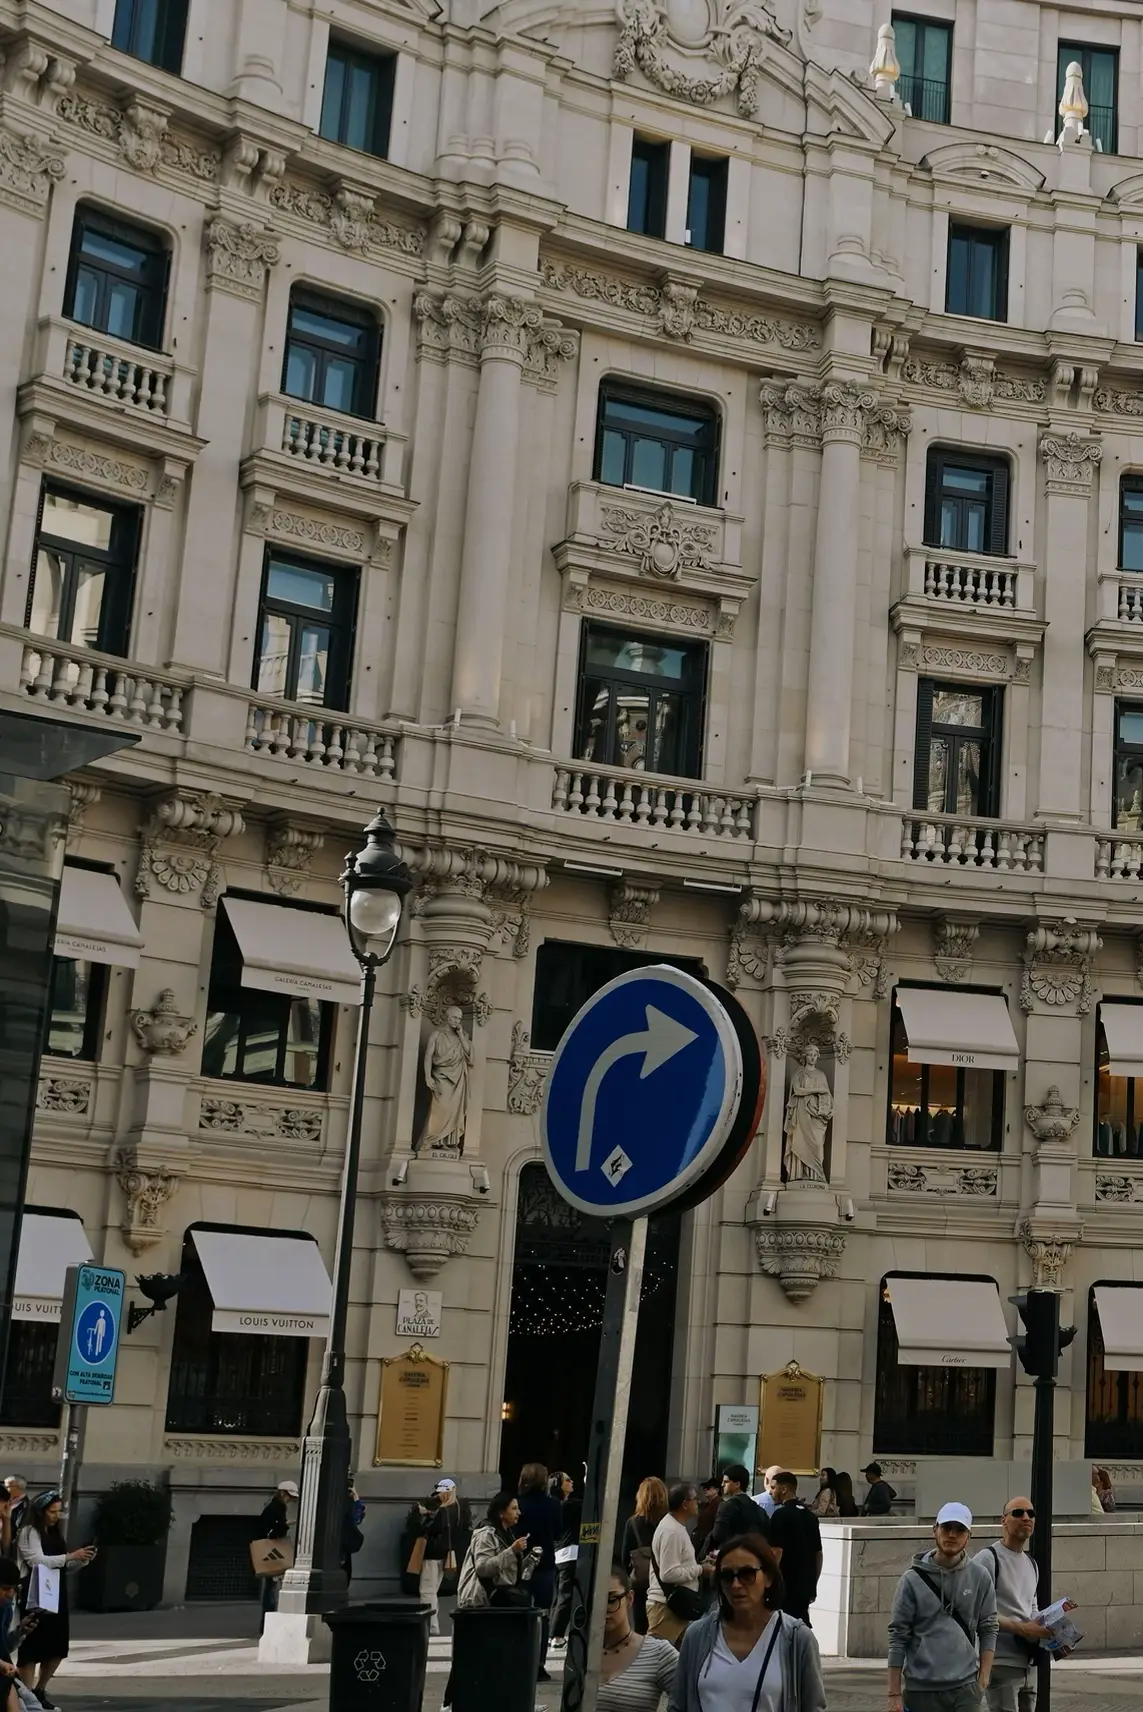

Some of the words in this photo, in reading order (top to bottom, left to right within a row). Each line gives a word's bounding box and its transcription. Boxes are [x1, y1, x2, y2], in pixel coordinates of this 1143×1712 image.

[952, 1054, 975, 1063] DIOR
[95, 1275, 120, 1289] ZONA
[15, 1302, 31, 1312] UIS
[35, 1303, 60, 1314] VUIT
[240, 1317, 269, 1327] LOUIS
[272, 1318, 314, 1329] VUITTON
[941, 1354, 967, 1363] Cartier
